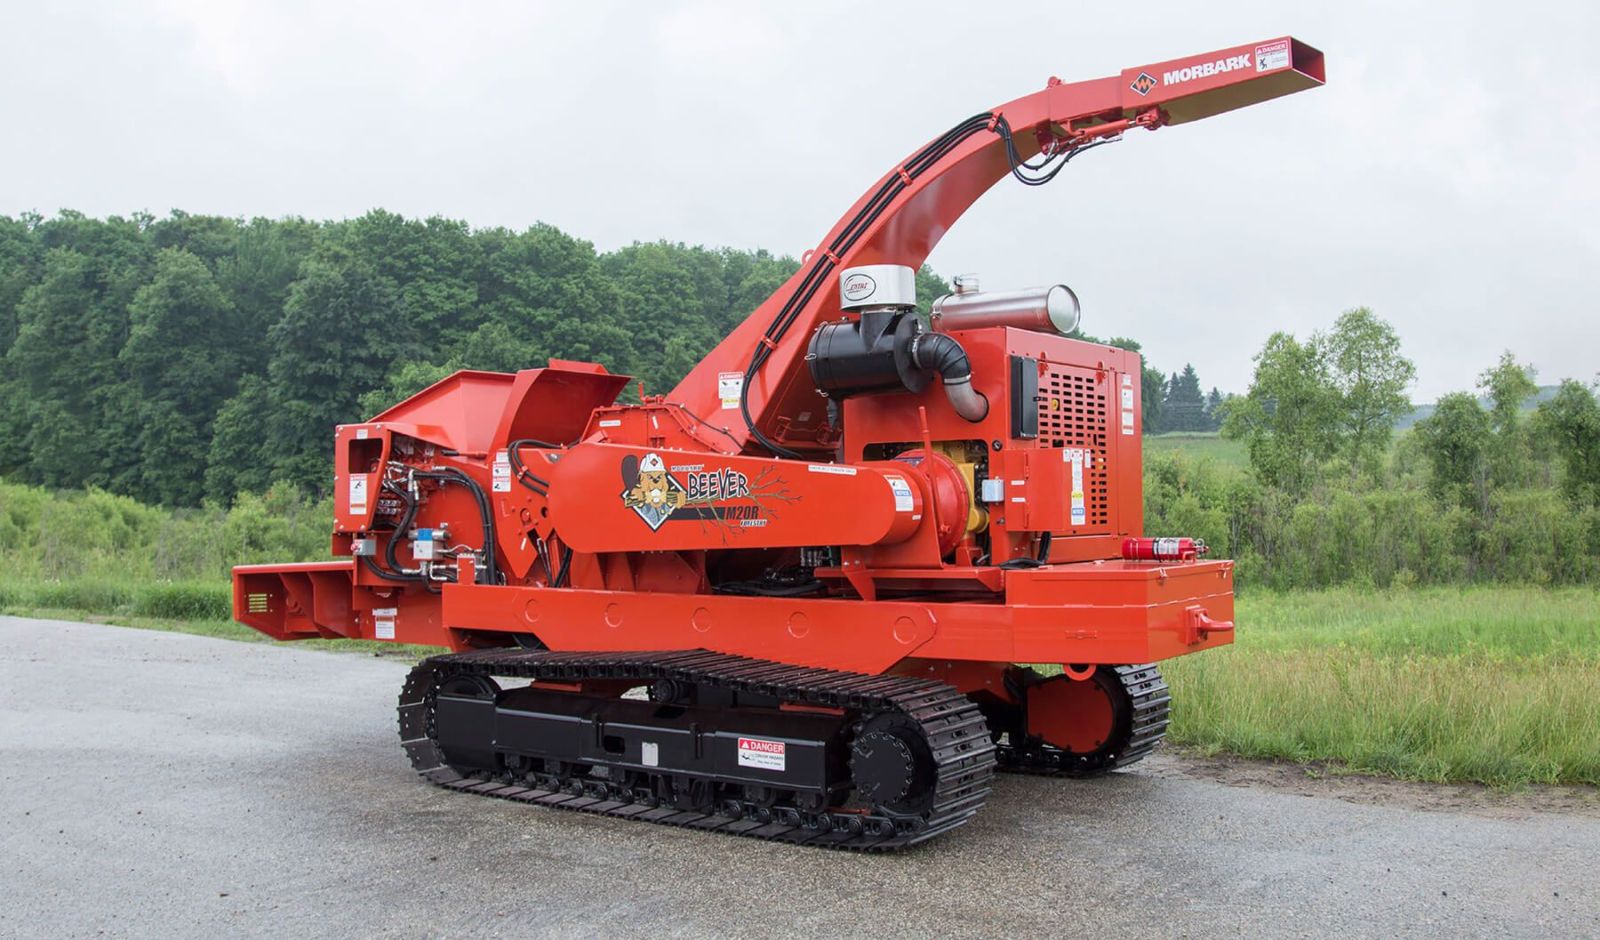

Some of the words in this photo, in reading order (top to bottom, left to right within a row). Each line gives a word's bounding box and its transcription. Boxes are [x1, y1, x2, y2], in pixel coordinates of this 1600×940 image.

[1163, 53, 1252, 86] MORBARK
[687, 467, 749, 500] BEEVER
[726, 505, 759, 520] M20R
[750, 742, 784, 754] DANGER
